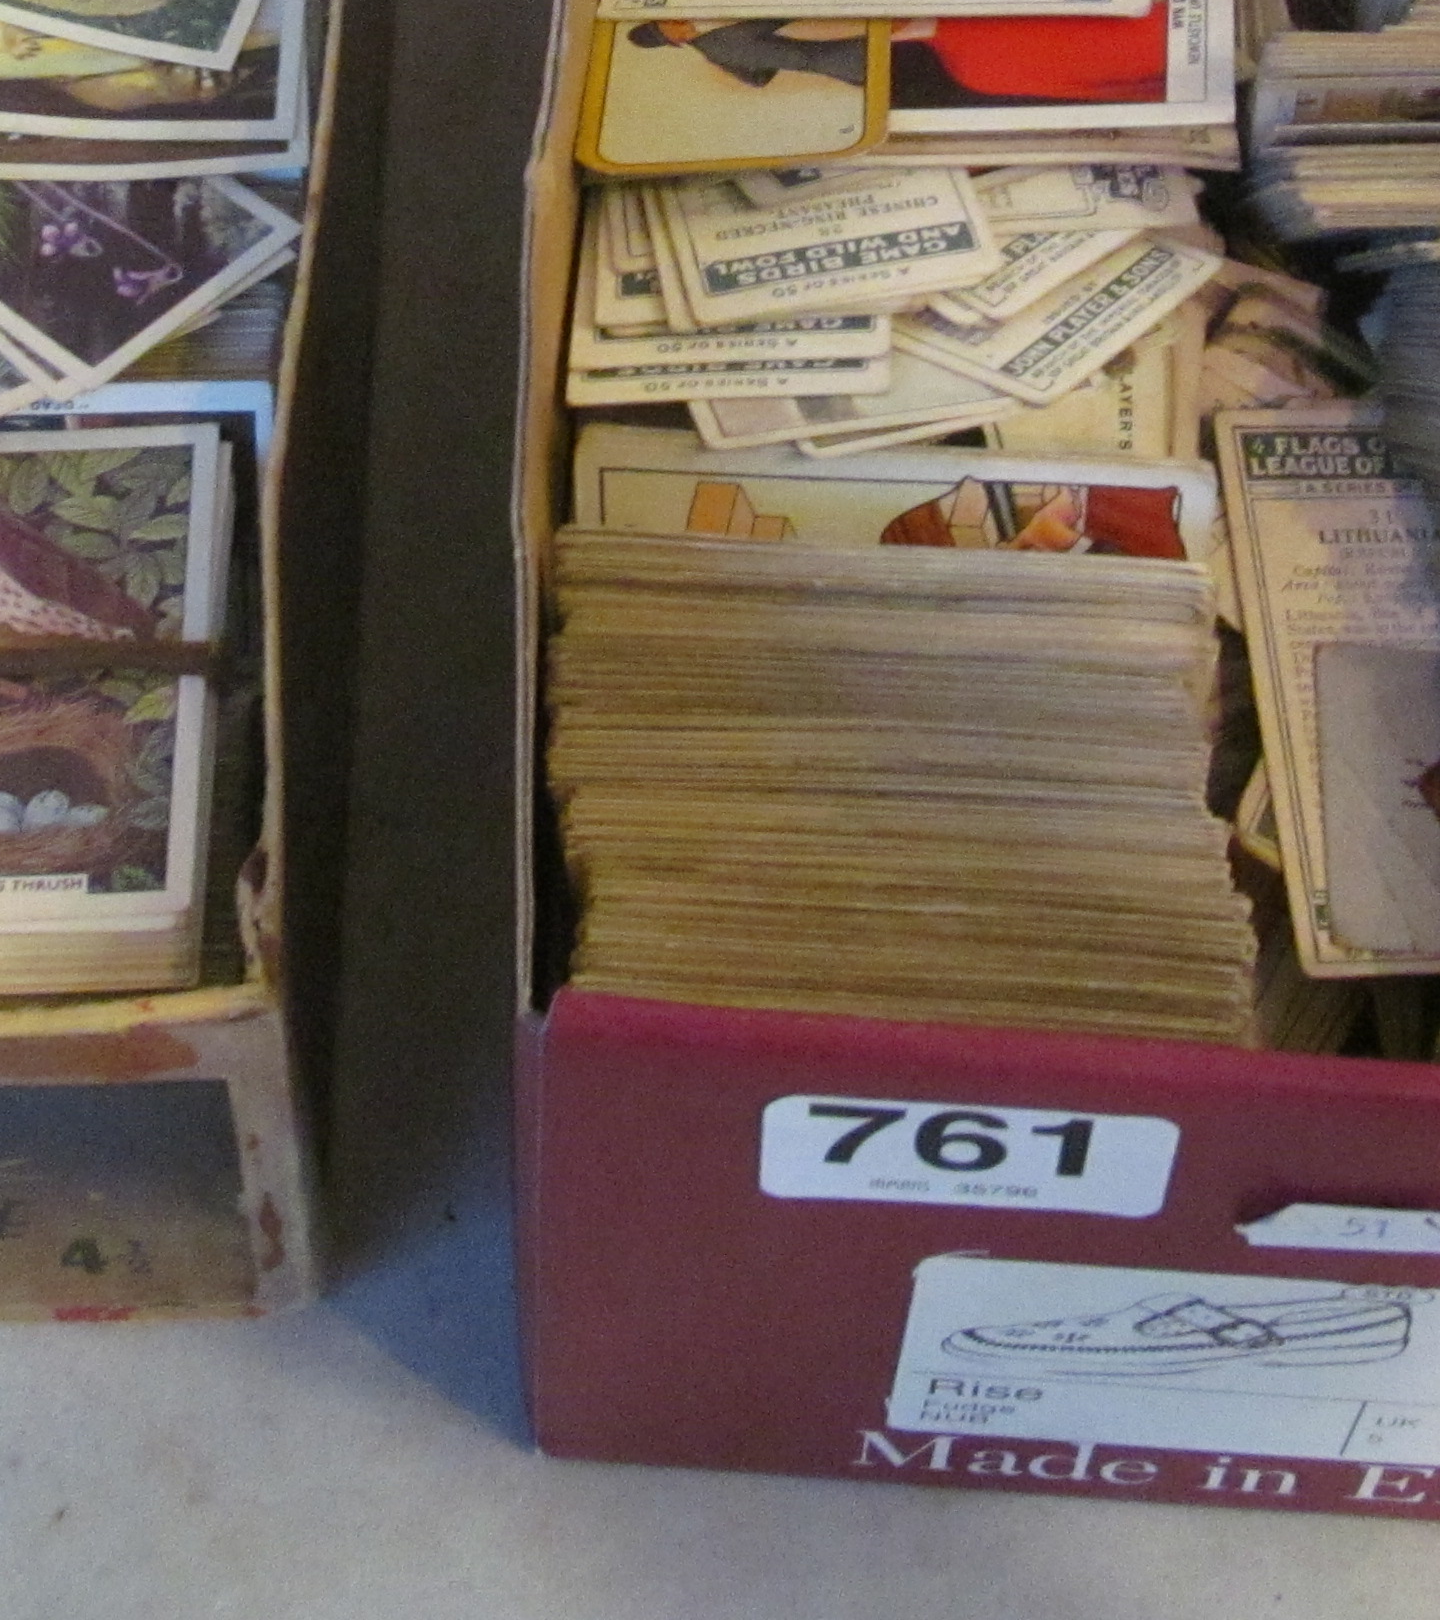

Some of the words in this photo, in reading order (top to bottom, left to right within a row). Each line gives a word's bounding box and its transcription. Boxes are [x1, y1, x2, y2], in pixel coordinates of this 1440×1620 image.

[1188, 14, 1201, 64] NEWCASTLE
[897, 222, 963, 244] AND
[804, 236, 888, 261] WILD
[860, 239, 948, 265] GAME
[714, 248, 797, 276] FOWL
[735, 256, 845, 286] BIRDS
[1007, 340, 1054, 376] JOHN
[1050, 293, 1110, 343] PLAYER
[1129, 248, 1173, 284] SONS
[656, 340, 683, 354] 50
[1117, 377, 1133, 452] AYER'S
[1274, 437, 1359, 454] FLAGS
[1252, 455, 1351, 474] LEAGUE
[1354, 457, 1384, 473] OF
[12, 878, 83, 893] THRUSH
[807, 1101, 1095, 1179] 761
[927, 1377, 1044, 1402] Rise
[850, 1429, 1160, 1486] Made
[1200, 1454, 1301, 1498] in
